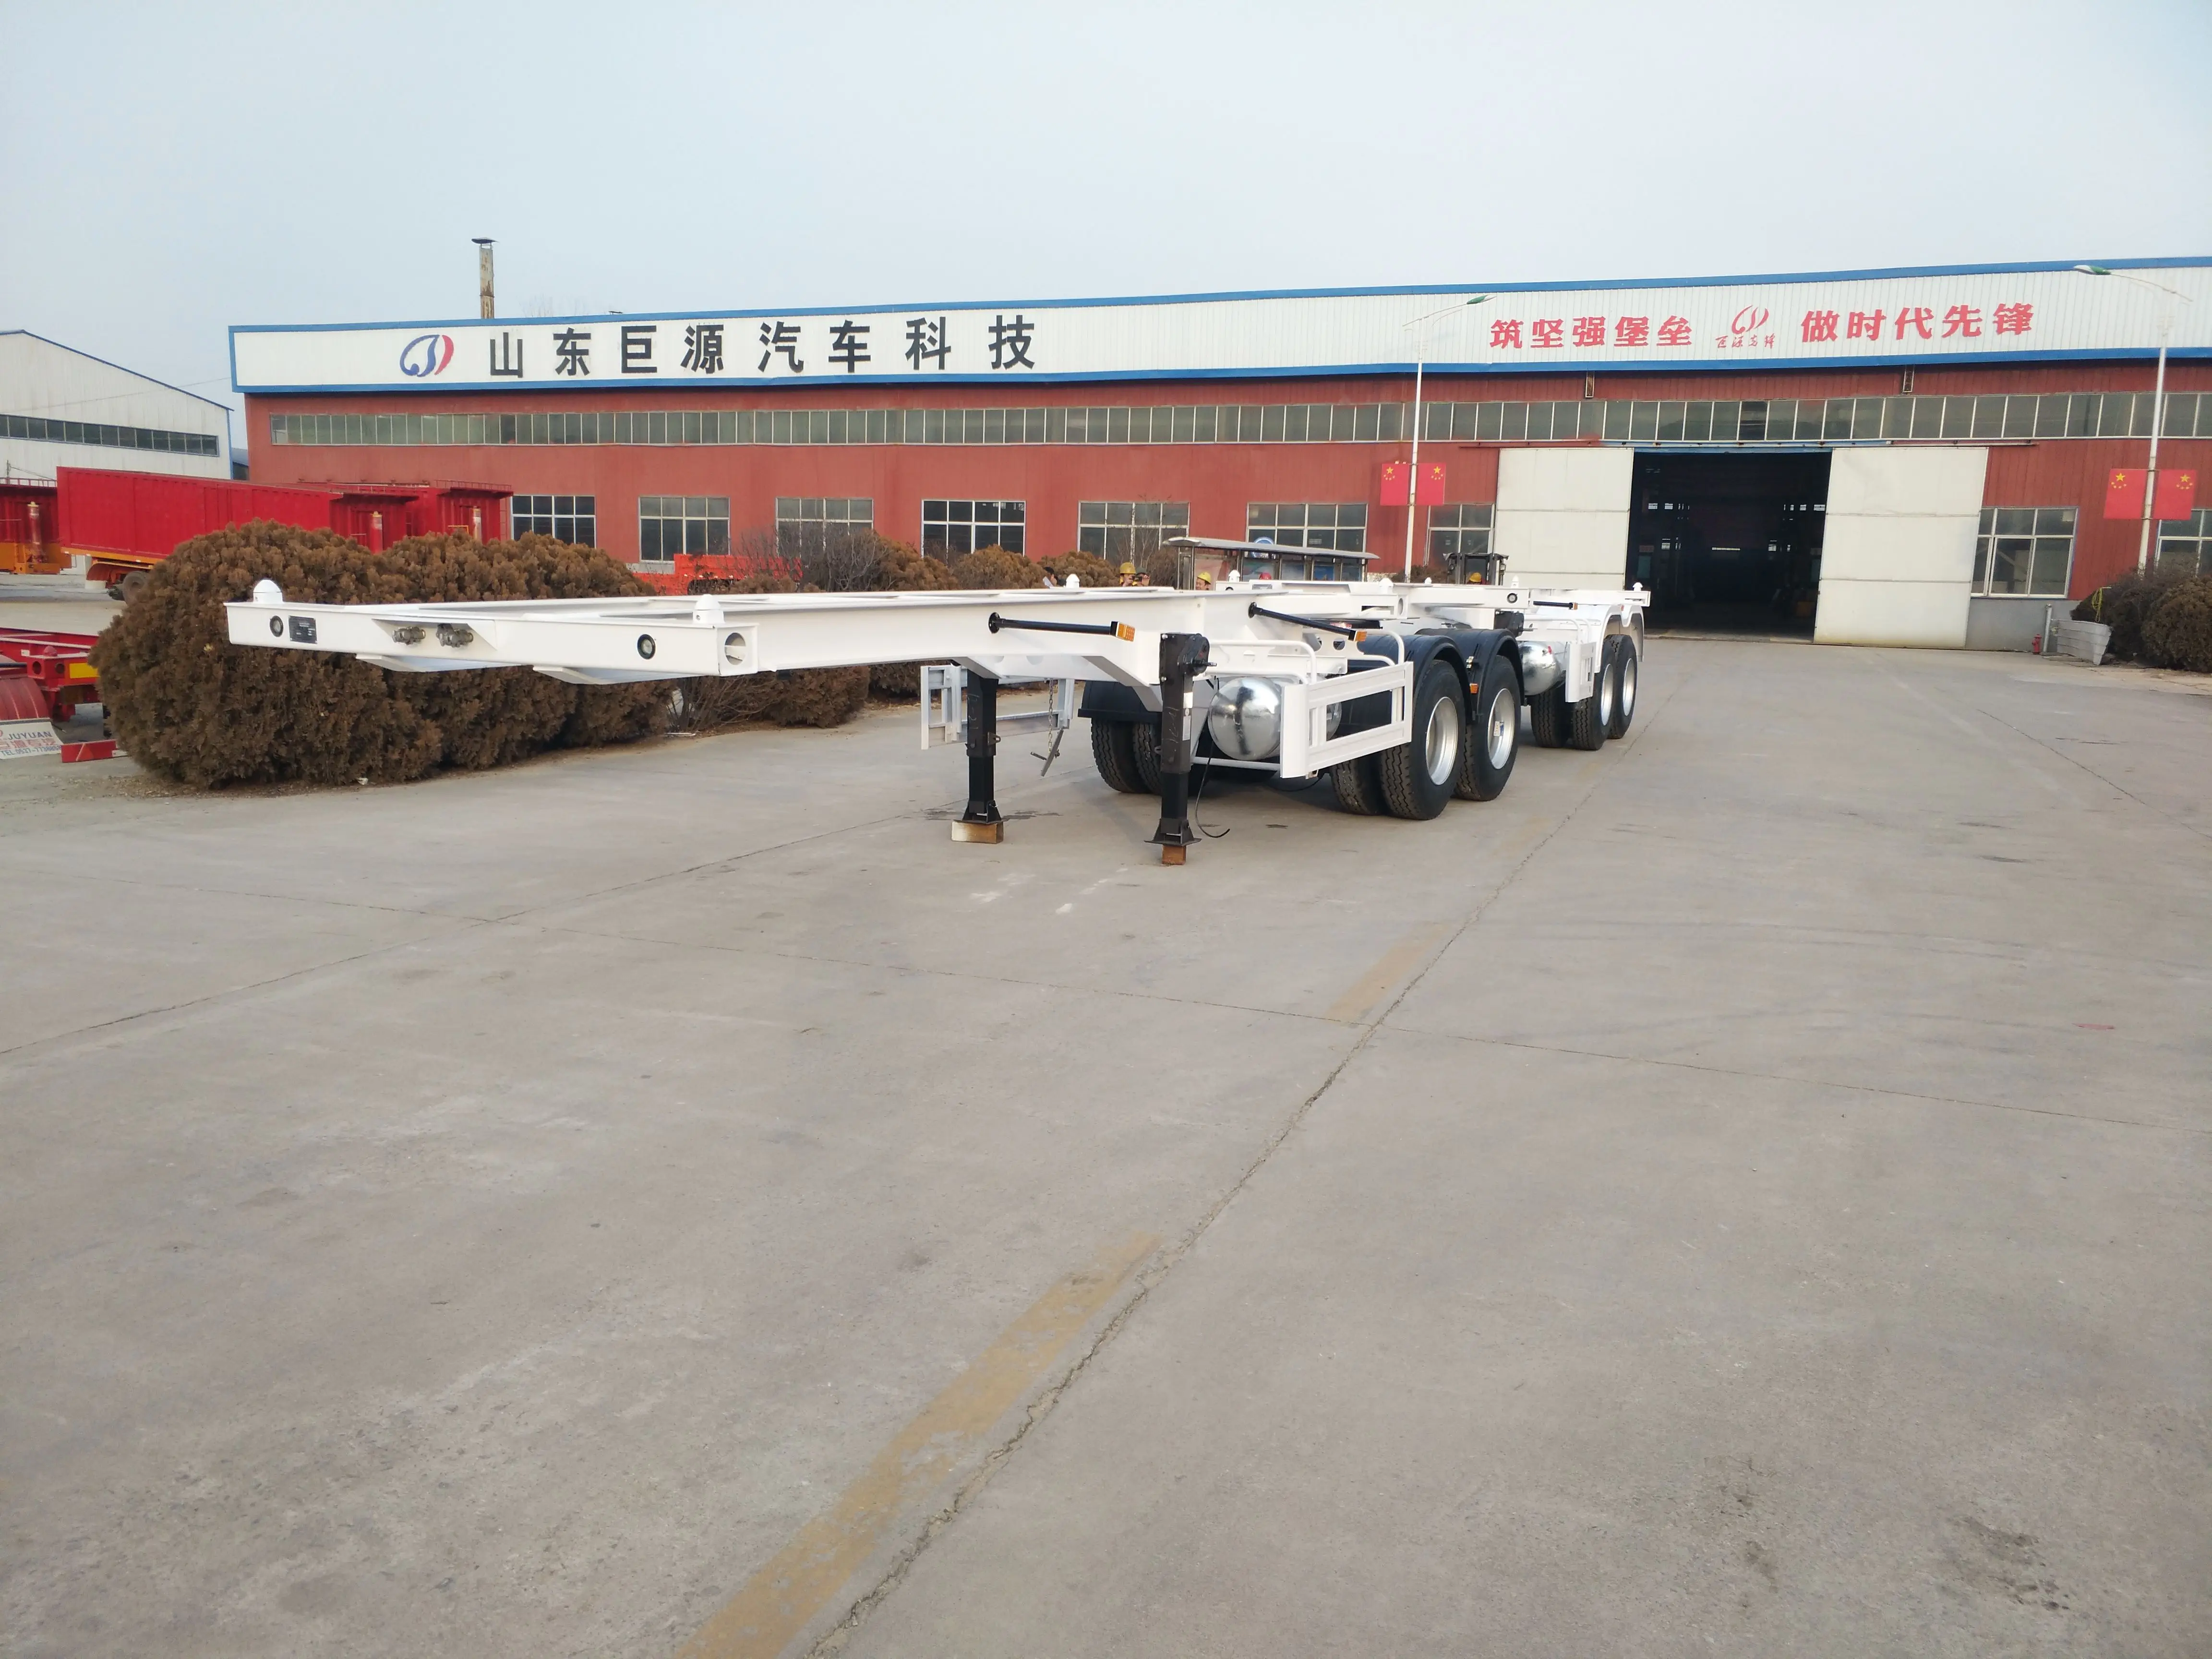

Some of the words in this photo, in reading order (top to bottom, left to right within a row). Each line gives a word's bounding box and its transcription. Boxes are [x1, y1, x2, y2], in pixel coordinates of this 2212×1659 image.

[490, 314, 1035, 378] 山东巨源汽车科技
[1489, 315, 1693, 349] 筑坚强堡垒
[1801, 302, 2034, 343] 做时代先锋
[8, 731, 53, 740] JUYUAN
